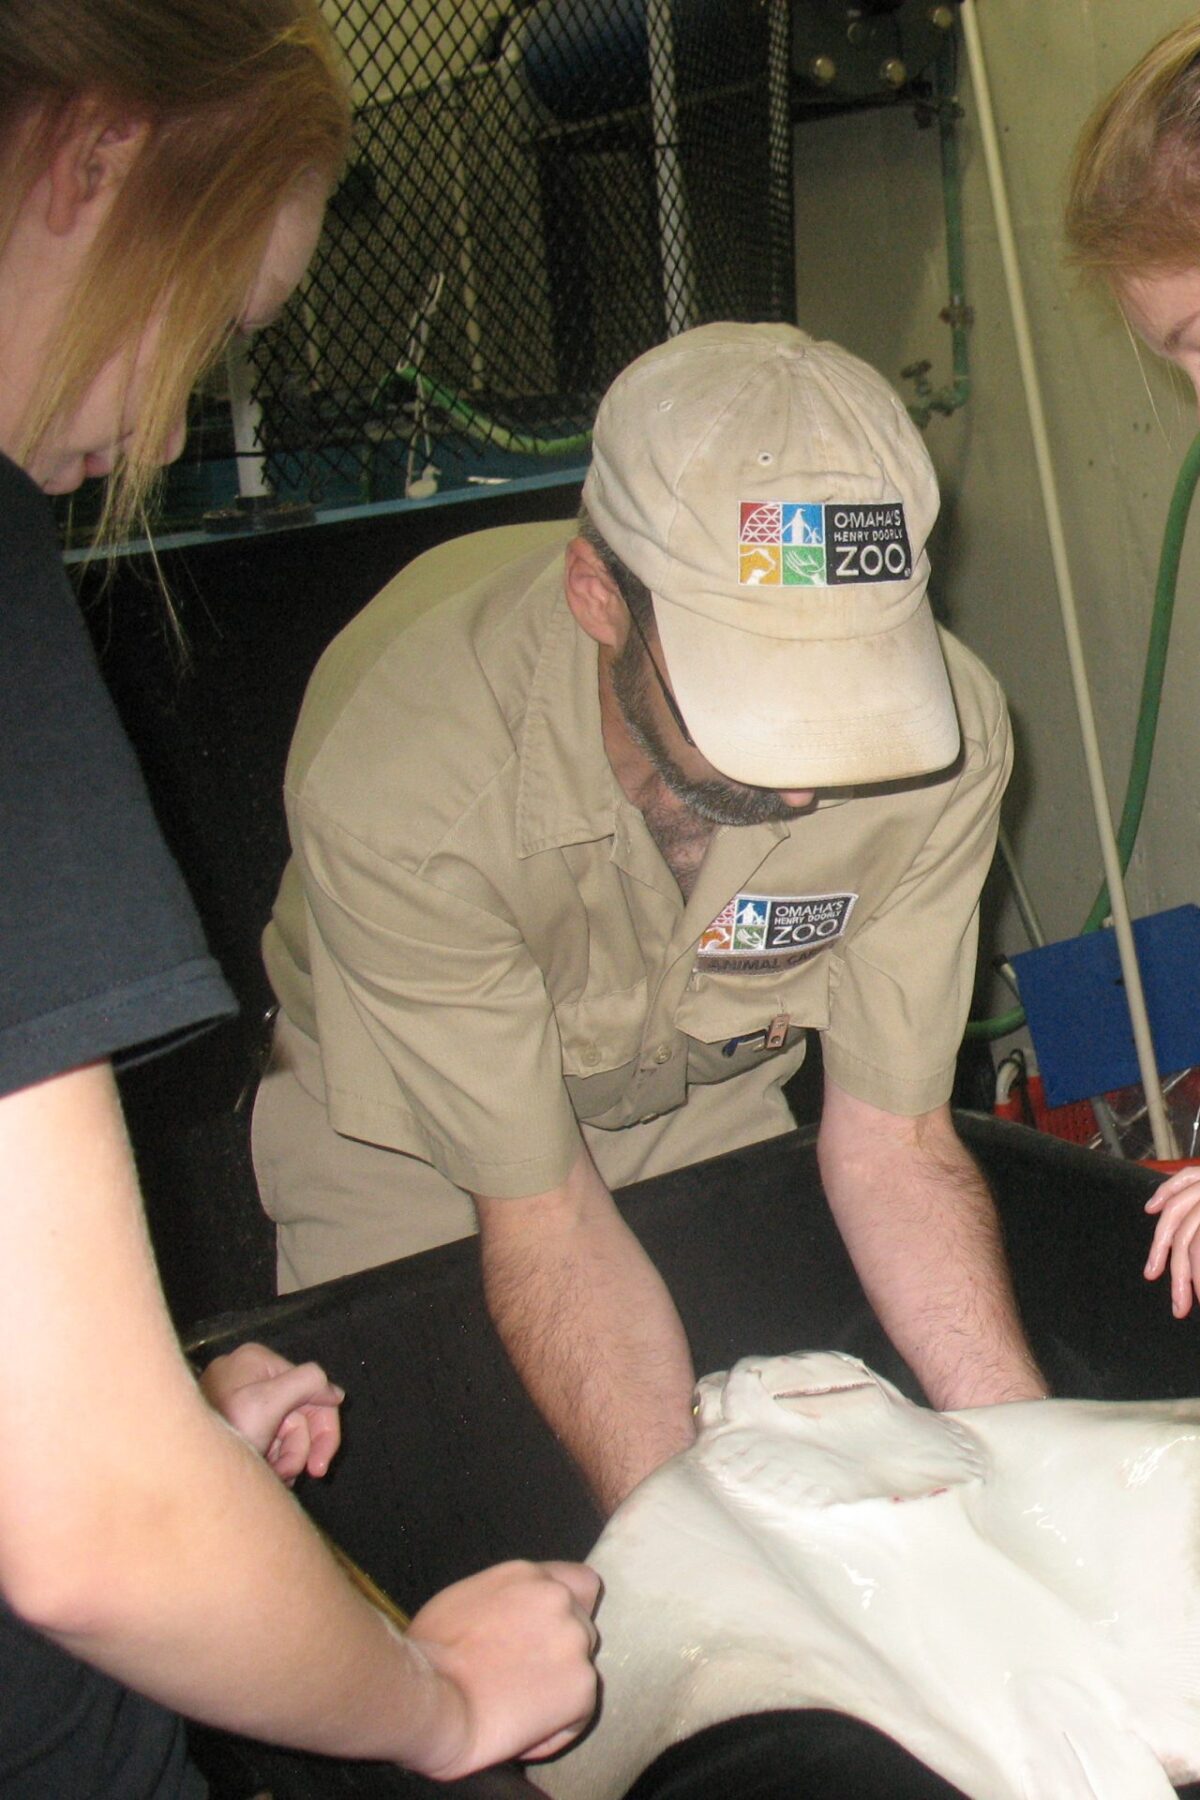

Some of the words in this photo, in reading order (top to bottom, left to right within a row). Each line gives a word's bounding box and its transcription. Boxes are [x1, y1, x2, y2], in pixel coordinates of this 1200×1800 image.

[834, 510, 901, 528] OMAHA'S
[834, 531, 869, 542] HENRY
[872, 529, 902, 541] DOORLY
[836, 543, 906, 576] ZOO
[775, 900, 844, 917] OMAHA'S
[774, 917, 805, 925] HENRY
[807, 910, 842, 922] DOORLY
[772, 919, 839, 945] ZOO
[708, 957, 781, 971] ANIMAL
